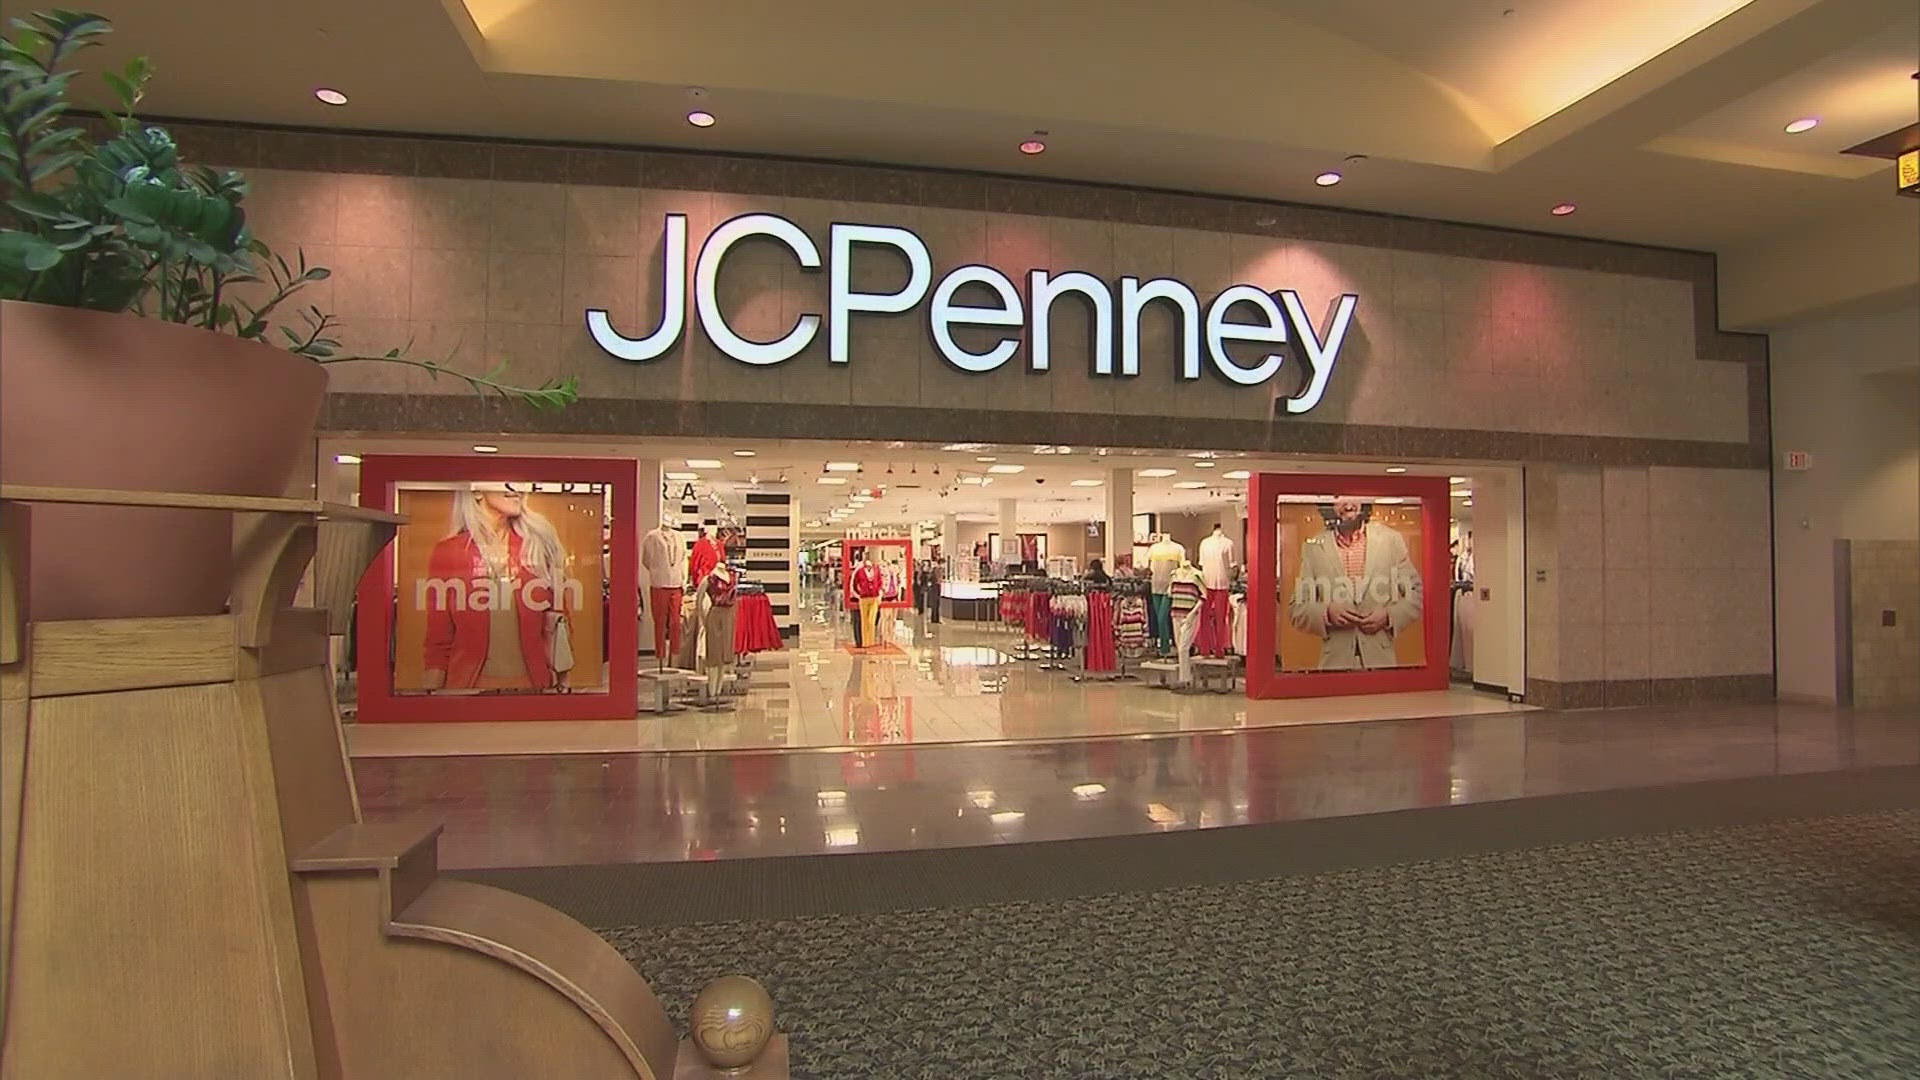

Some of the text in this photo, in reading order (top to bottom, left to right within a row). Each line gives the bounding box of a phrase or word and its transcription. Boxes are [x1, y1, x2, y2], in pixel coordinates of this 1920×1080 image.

[586, 212, 1358, 415] JCPenney
[847, 525, 899, 540] march
[416, 566, 584, 611] march
[1296, 567, 1411, 604] march
